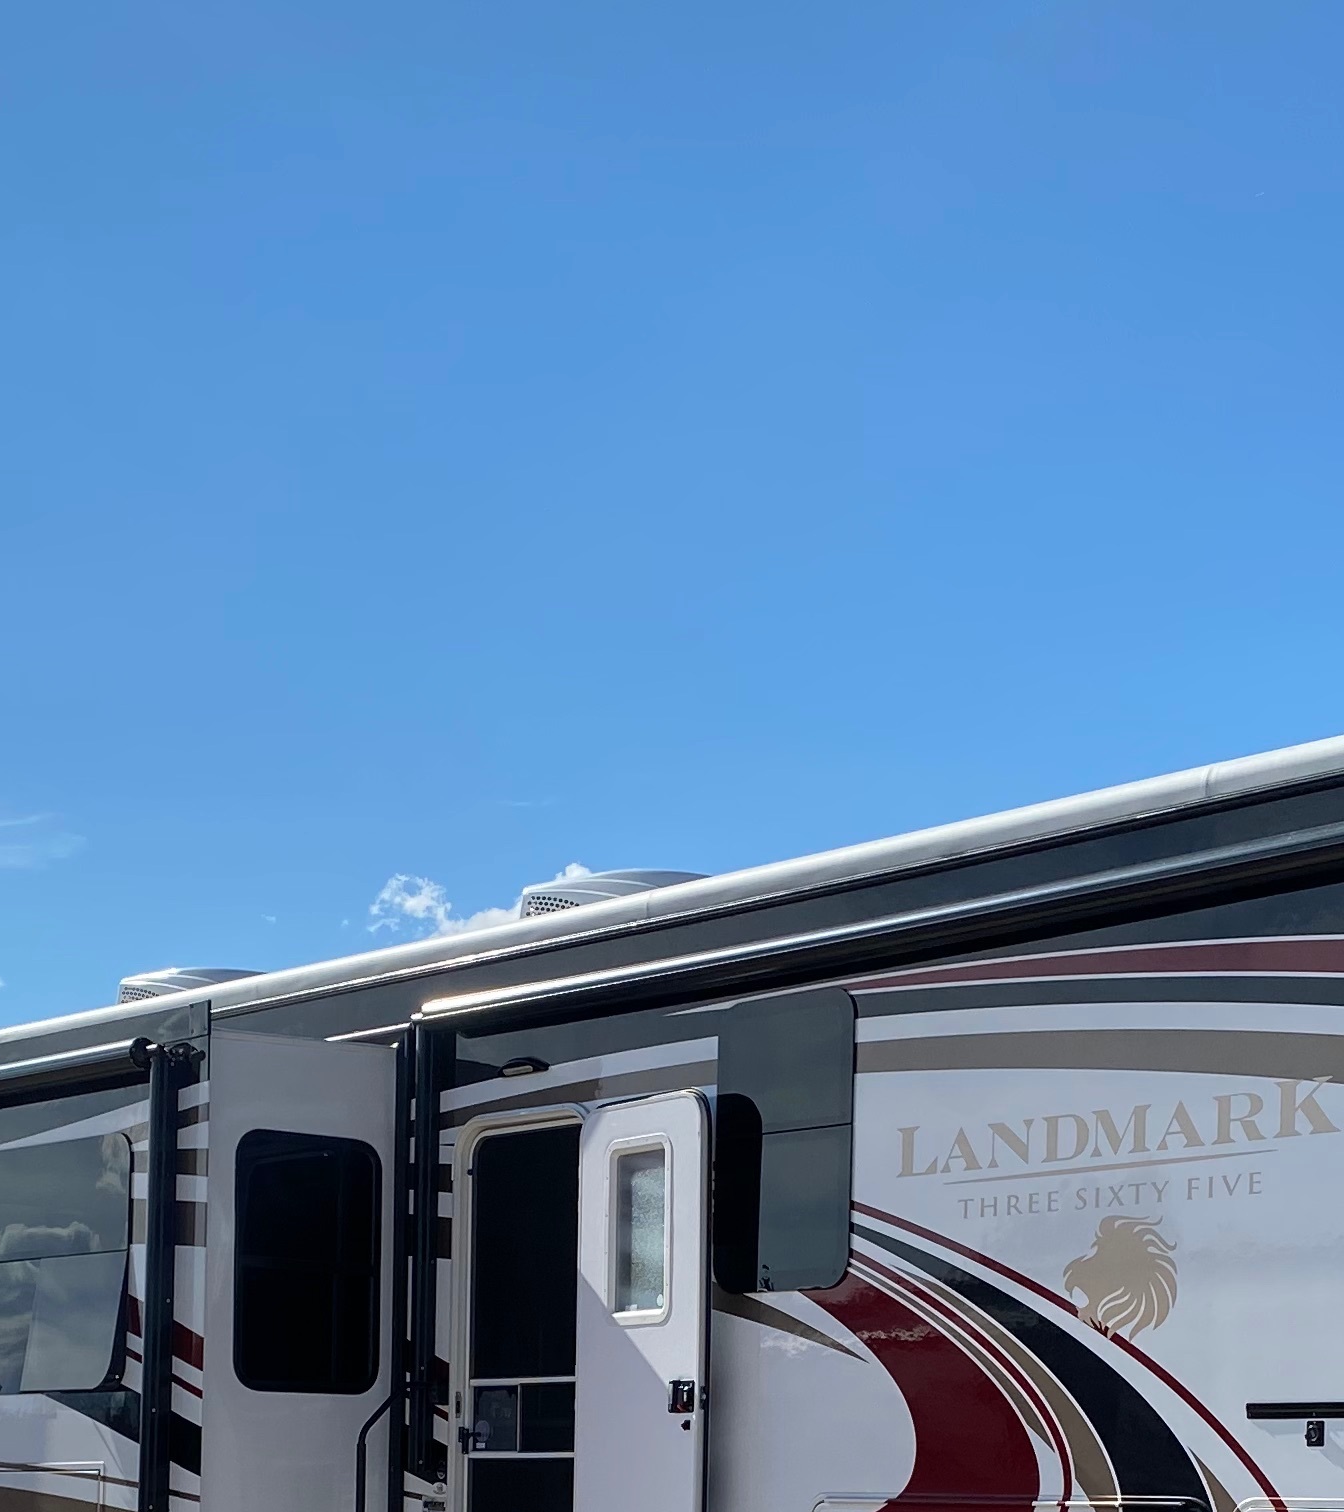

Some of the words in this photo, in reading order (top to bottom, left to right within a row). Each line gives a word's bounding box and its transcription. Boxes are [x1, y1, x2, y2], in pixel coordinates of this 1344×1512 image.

[896, 1076, 1342, 1178] LANDMARK
[957, 1190, 1060, 1220] THREE
[1074, 1180, 1169, 1211] SIXTY
[1186, 1171, 1263, 1201] FIVE
